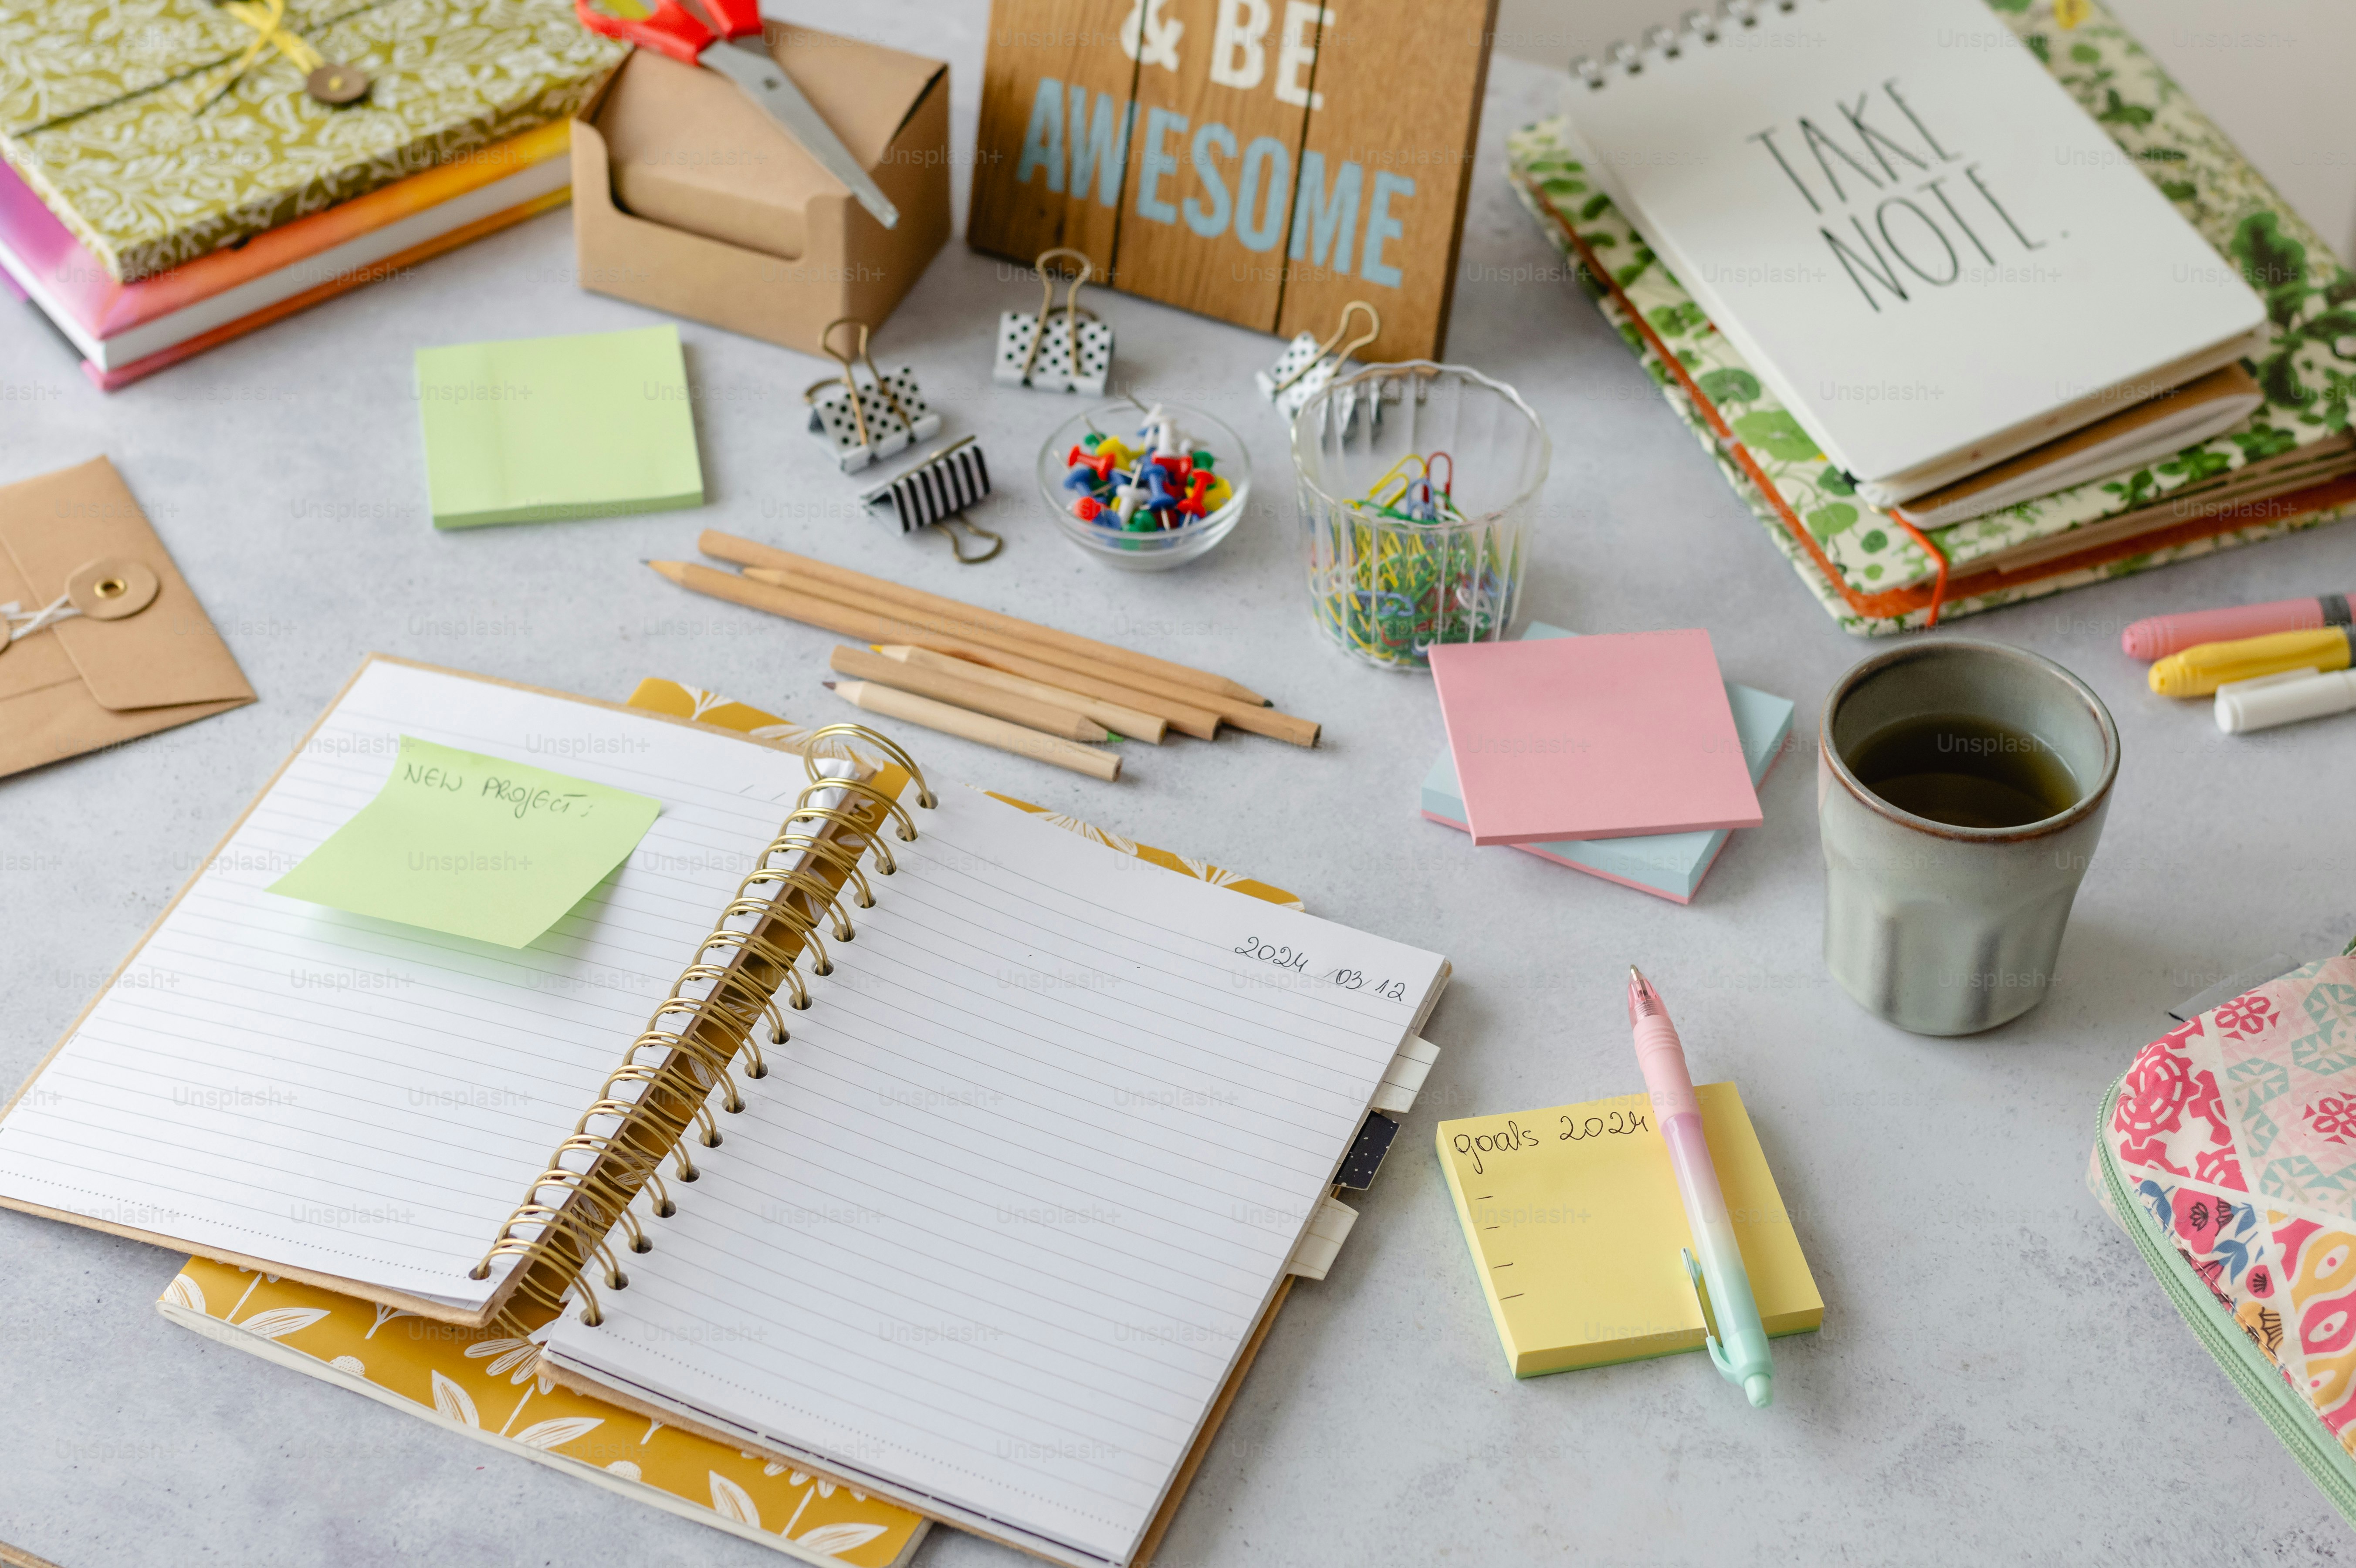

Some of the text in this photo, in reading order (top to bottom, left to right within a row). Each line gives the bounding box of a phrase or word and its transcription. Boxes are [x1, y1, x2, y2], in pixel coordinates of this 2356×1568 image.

[1120, 0, 1336, 111] & BE
[1017, 77, 1415, 289] AWESOME
[1744, 76, 1963, 214] TAKE
[403, 763, 463, 792] NEW
[1234, 936, 1309, 972] 2024
[1375, 979, 1405, 1002] 12
[1453, 1111, 1649, 1175] goals 2024
